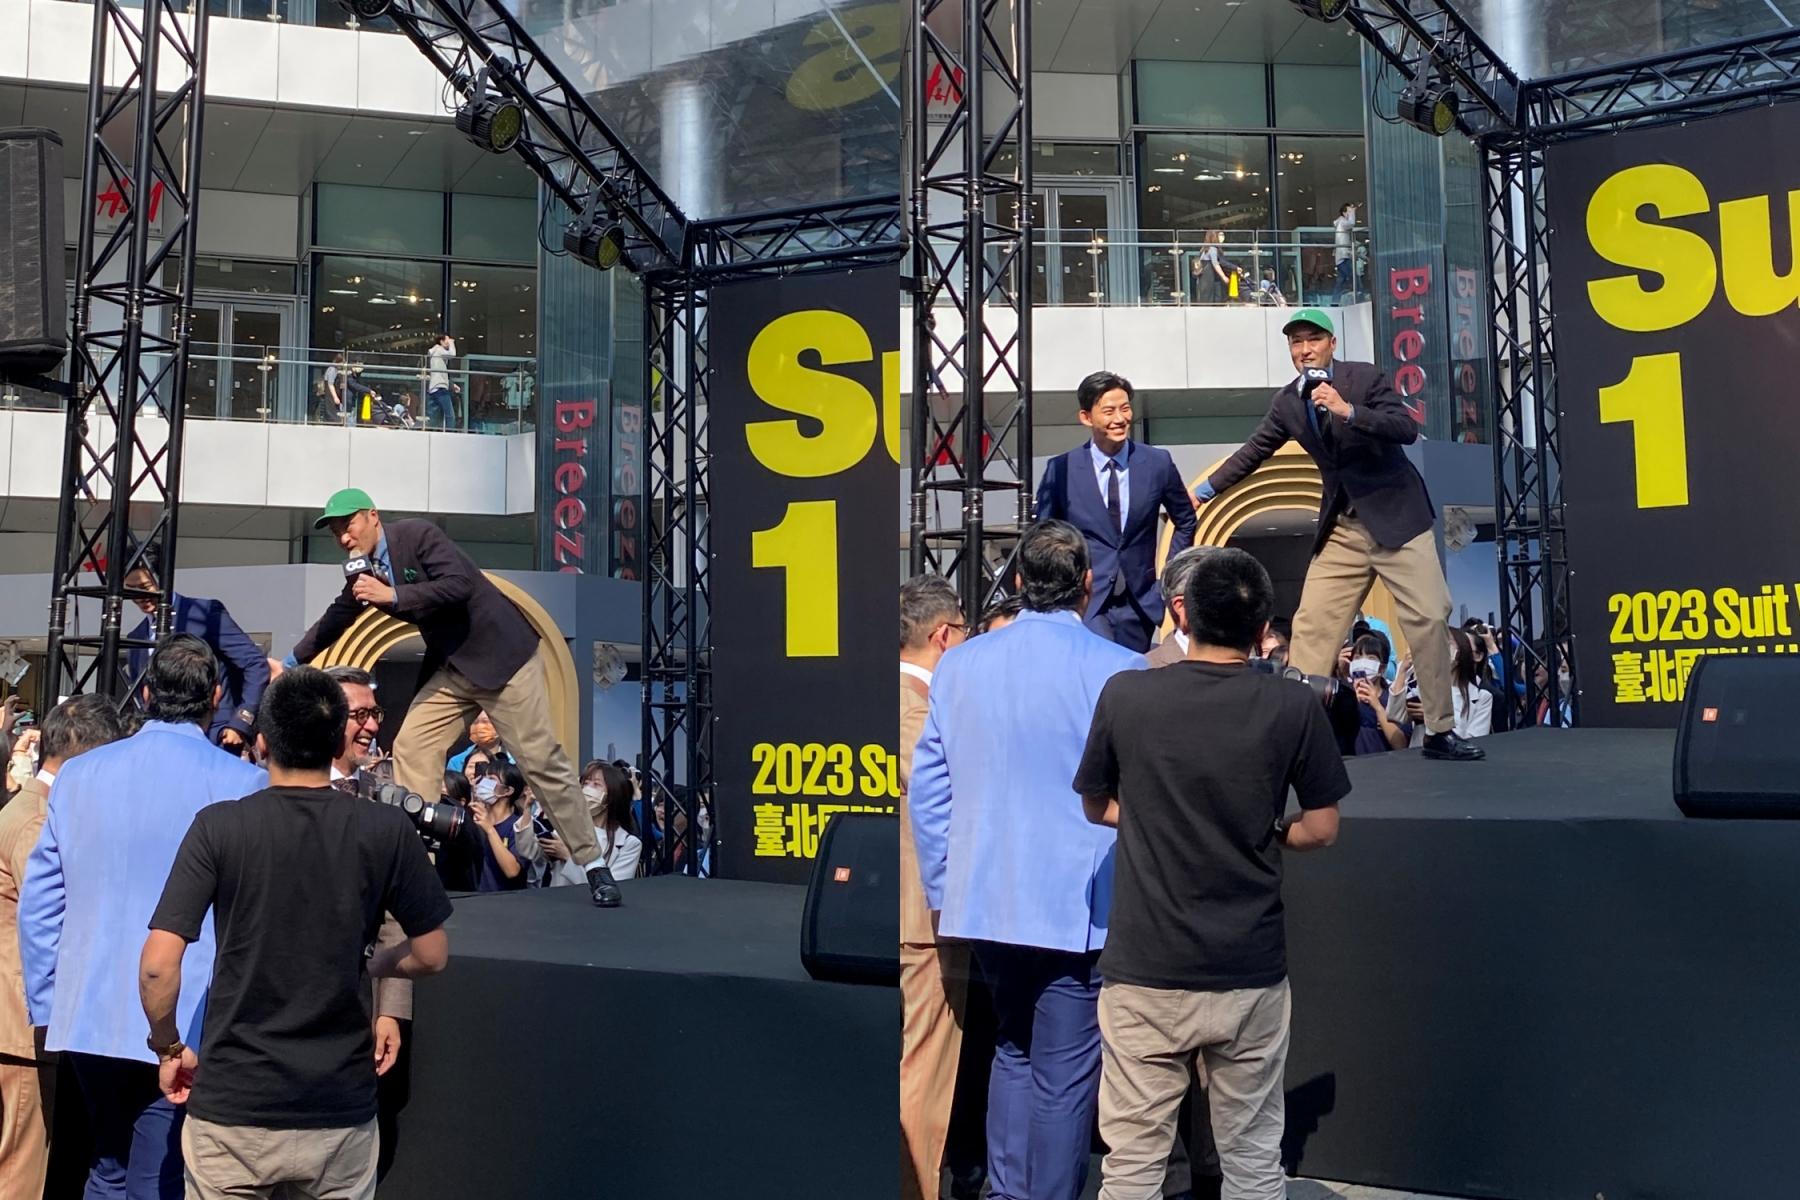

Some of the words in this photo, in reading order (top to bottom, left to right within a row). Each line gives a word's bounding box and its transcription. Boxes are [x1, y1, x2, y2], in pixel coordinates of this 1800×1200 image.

[745, 309, 901, 478] S
[1599, 351, 1689, 509] 1
[555, 400, 597, 574] Breez
[752, 500, 839, 658] 1
[1608, 588, 1709, 644] 2023
[1712, 583, 1792, 640] Suit
[751, 742, 854, 796] 2023
